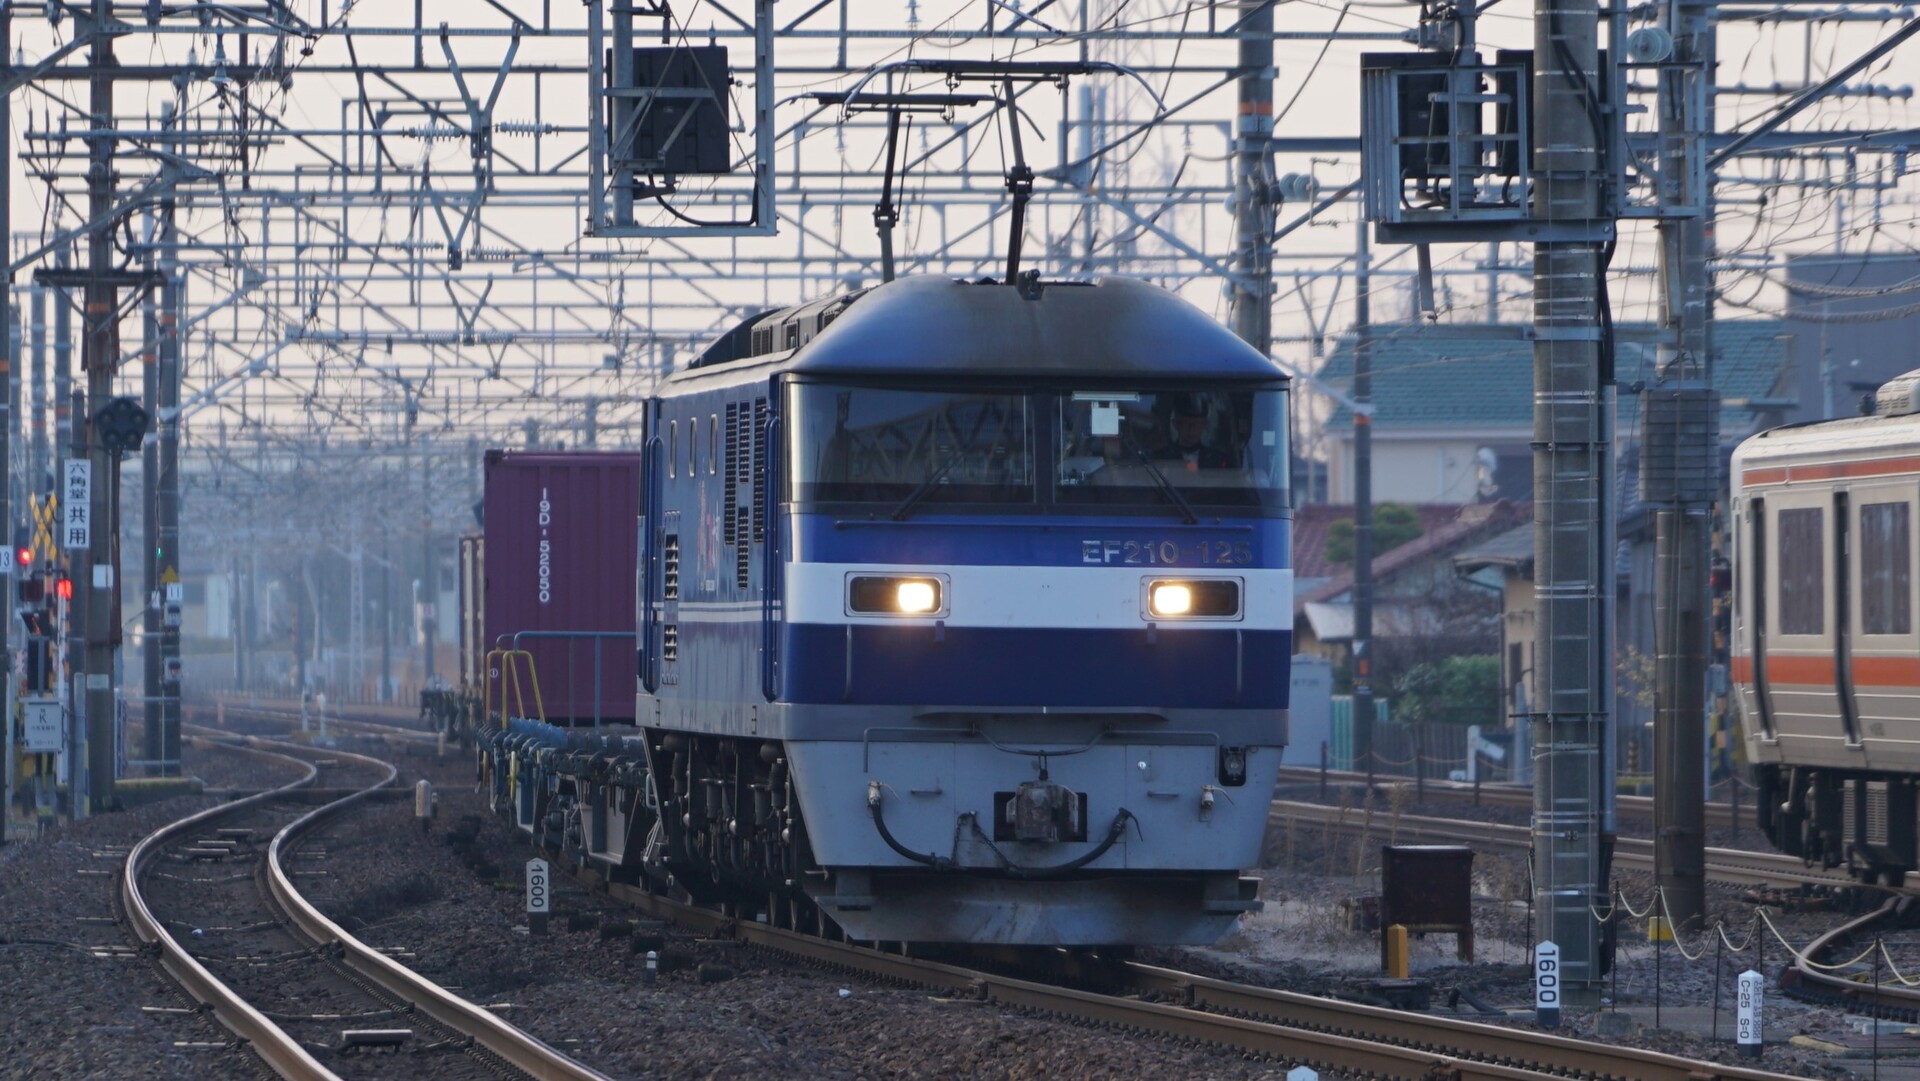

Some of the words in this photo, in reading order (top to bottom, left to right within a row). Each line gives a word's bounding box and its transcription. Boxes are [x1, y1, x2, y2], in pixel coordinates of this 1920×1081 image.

[539, 487, 550, 602] 19D-52050
[1082, 540, 1252, 564] EF210-125
[531, 864, 544, 908] 1600
[1538, 949, 1556, 1003] 1600
[1740, 980, 1751, 1009] C=25
